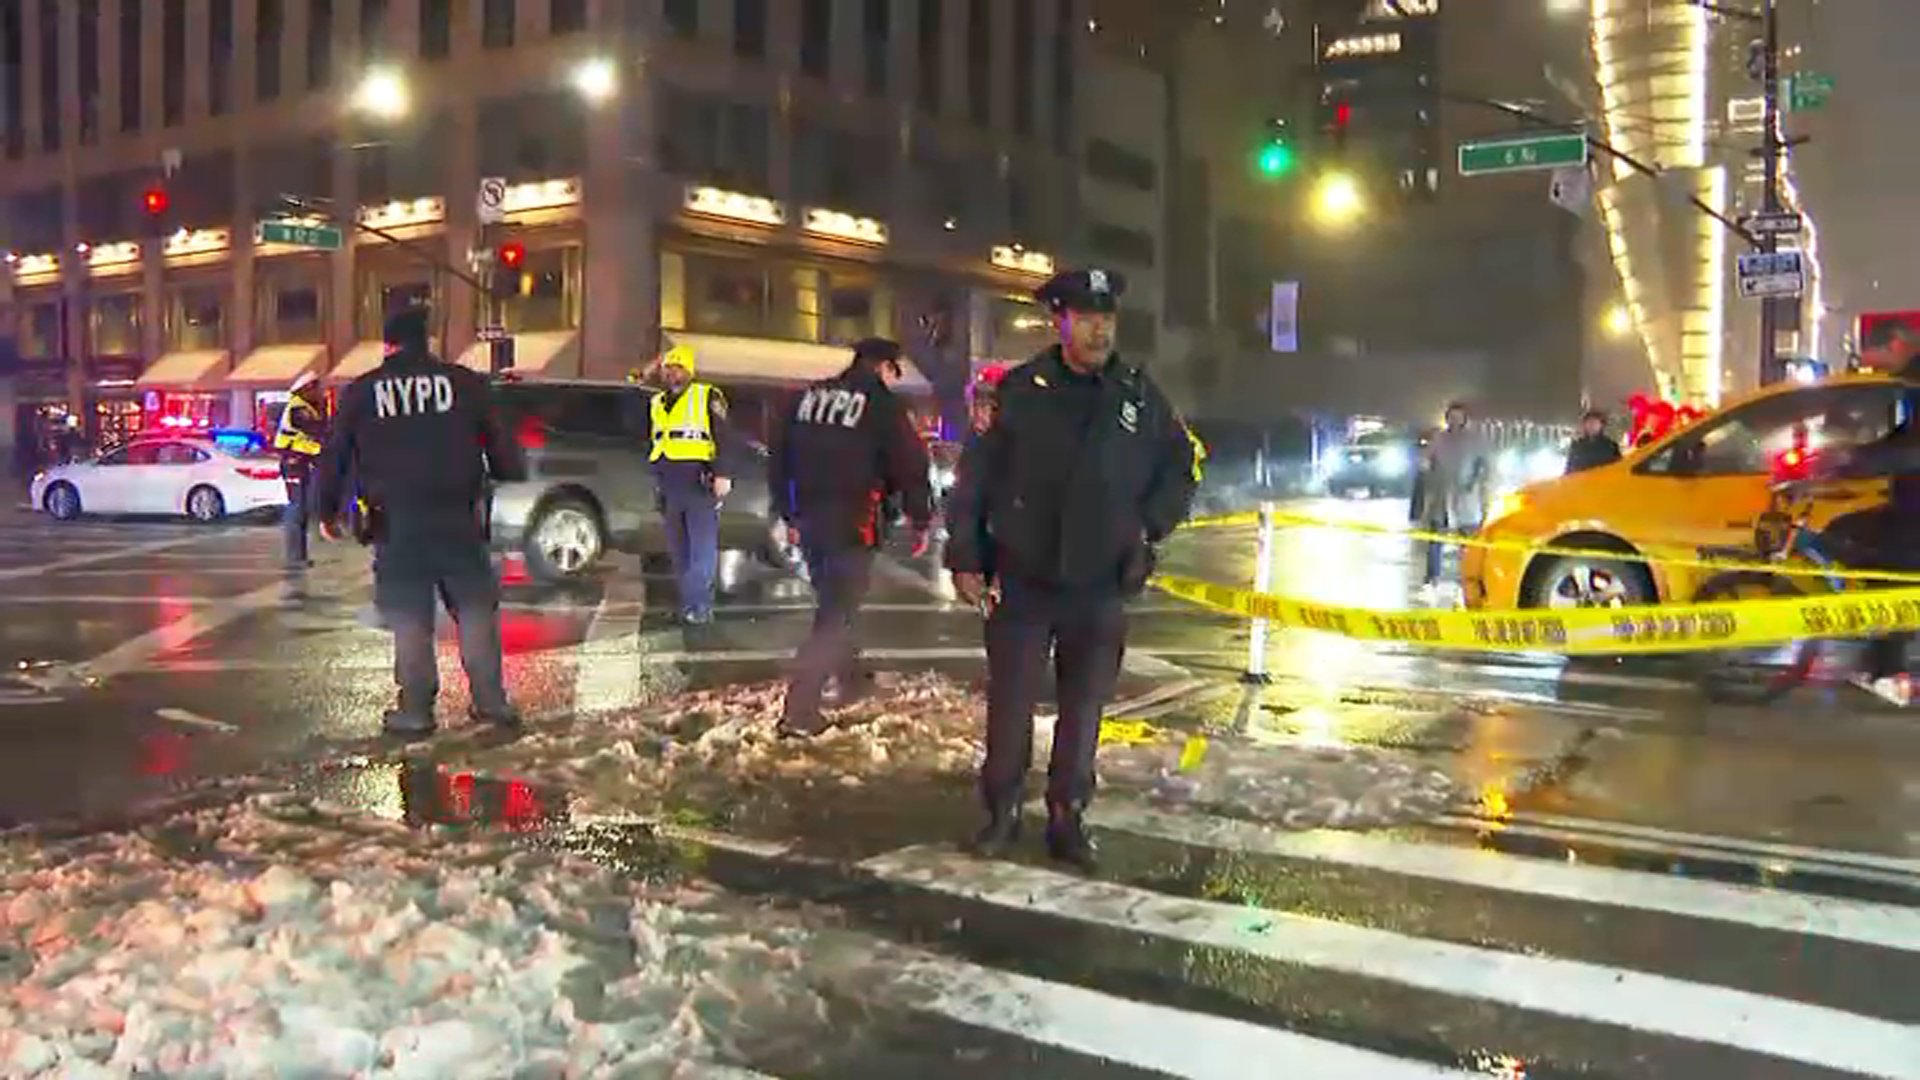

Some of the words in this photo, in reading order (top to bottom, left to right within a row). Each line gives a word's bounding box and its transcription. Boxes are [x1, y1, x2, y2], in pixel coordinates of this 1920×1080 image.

[1504, 149, 1514, 164] 6
[374, 374, 453, 418] NYPD
[797, 386, 867, 428] NYPD
